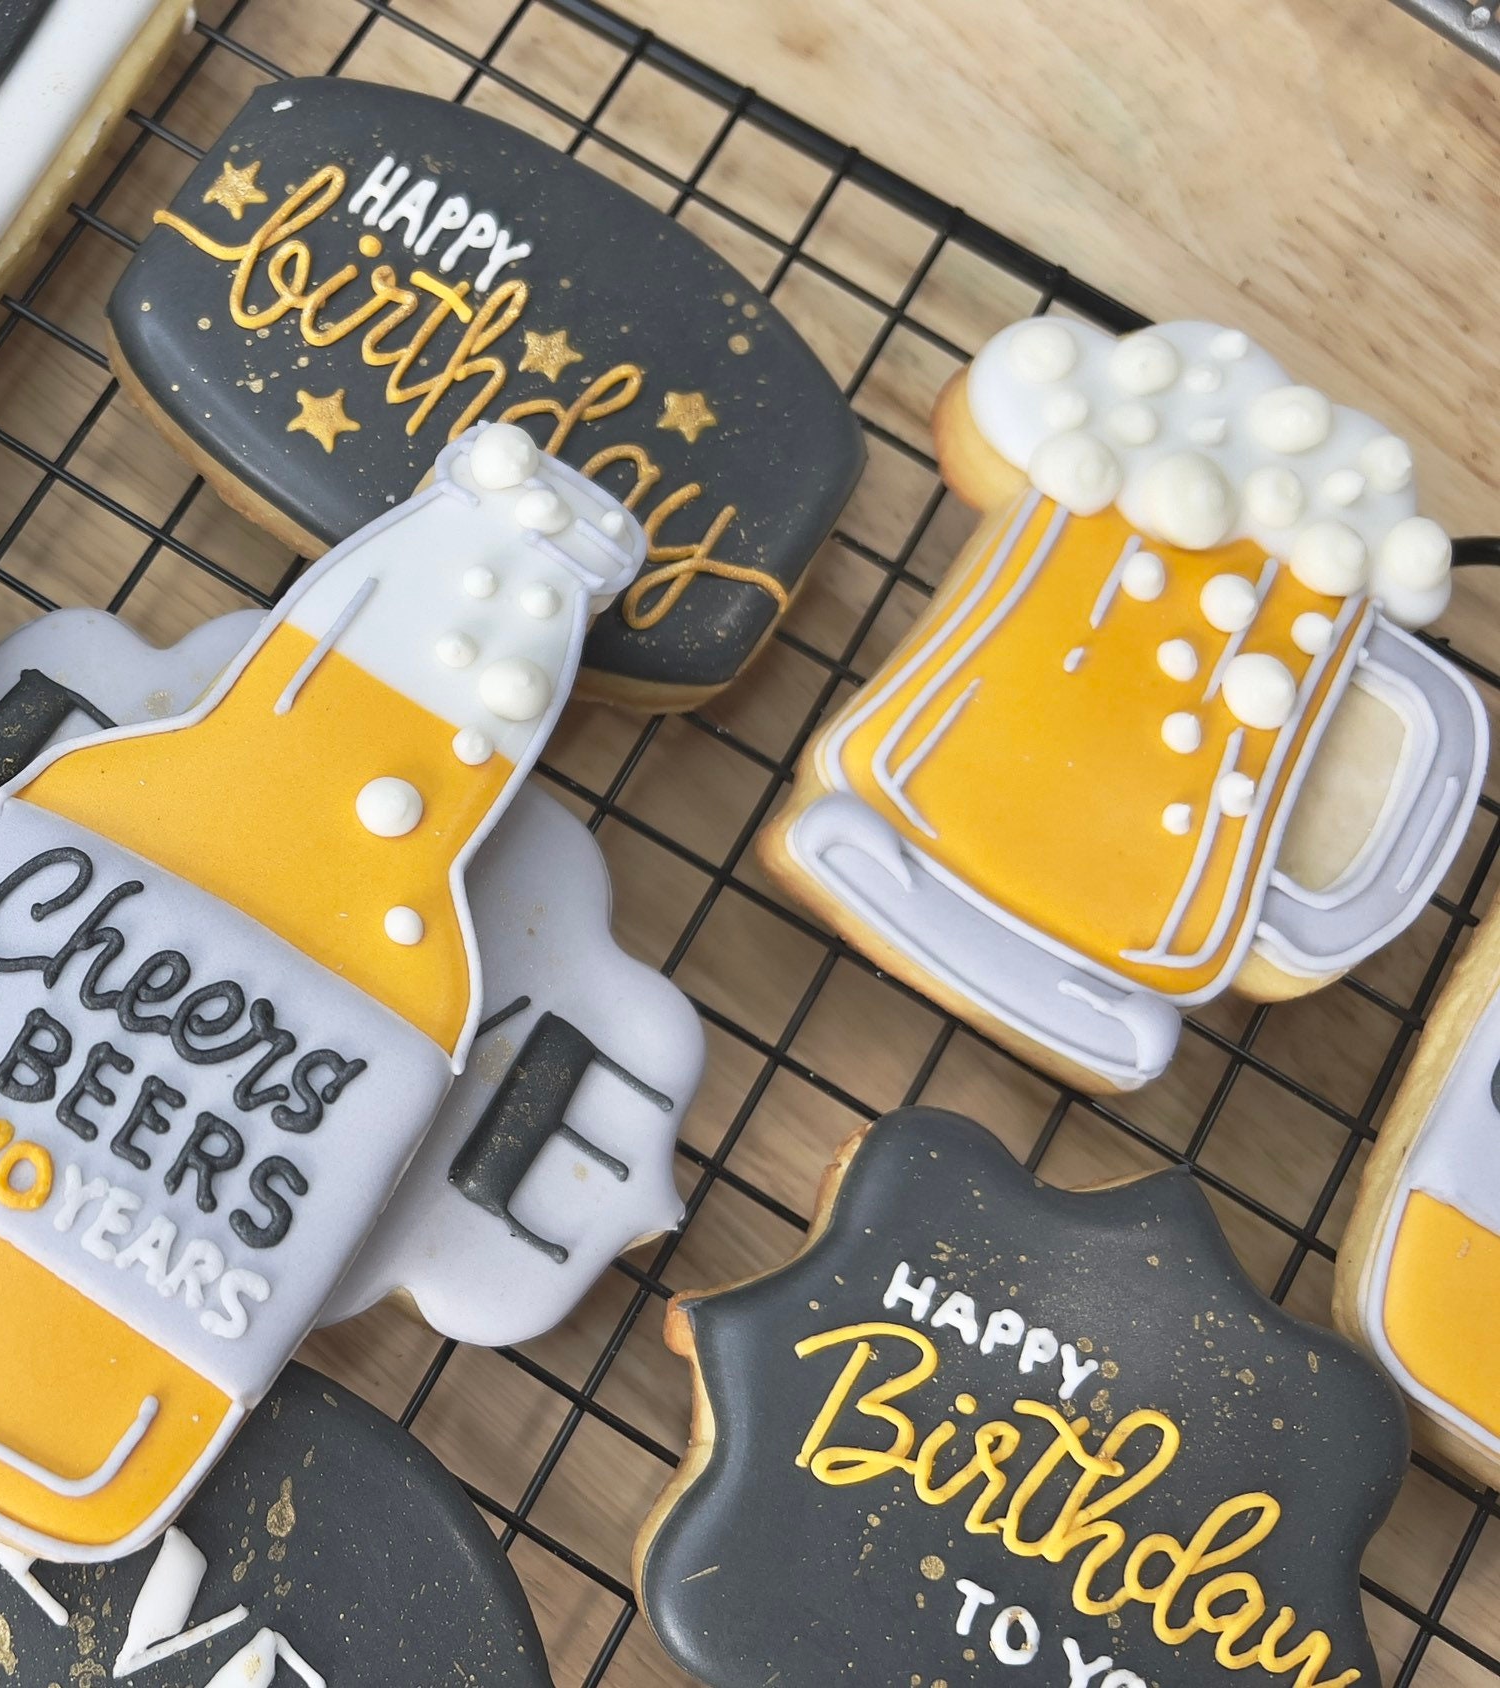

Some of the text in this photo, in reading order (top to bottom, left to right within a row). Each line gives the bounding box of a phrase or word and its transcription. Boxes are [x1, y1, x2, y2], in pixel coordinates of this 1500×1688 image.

[348, 155, 532, 293] HAPPY
[52, 1162, 270, 1339] YEARS
[882, 1261, 1099, 1400] HAPPY
[794, 1322, 1361, 1688] Birthday
[955, 1578, 1041, 1666] TO
